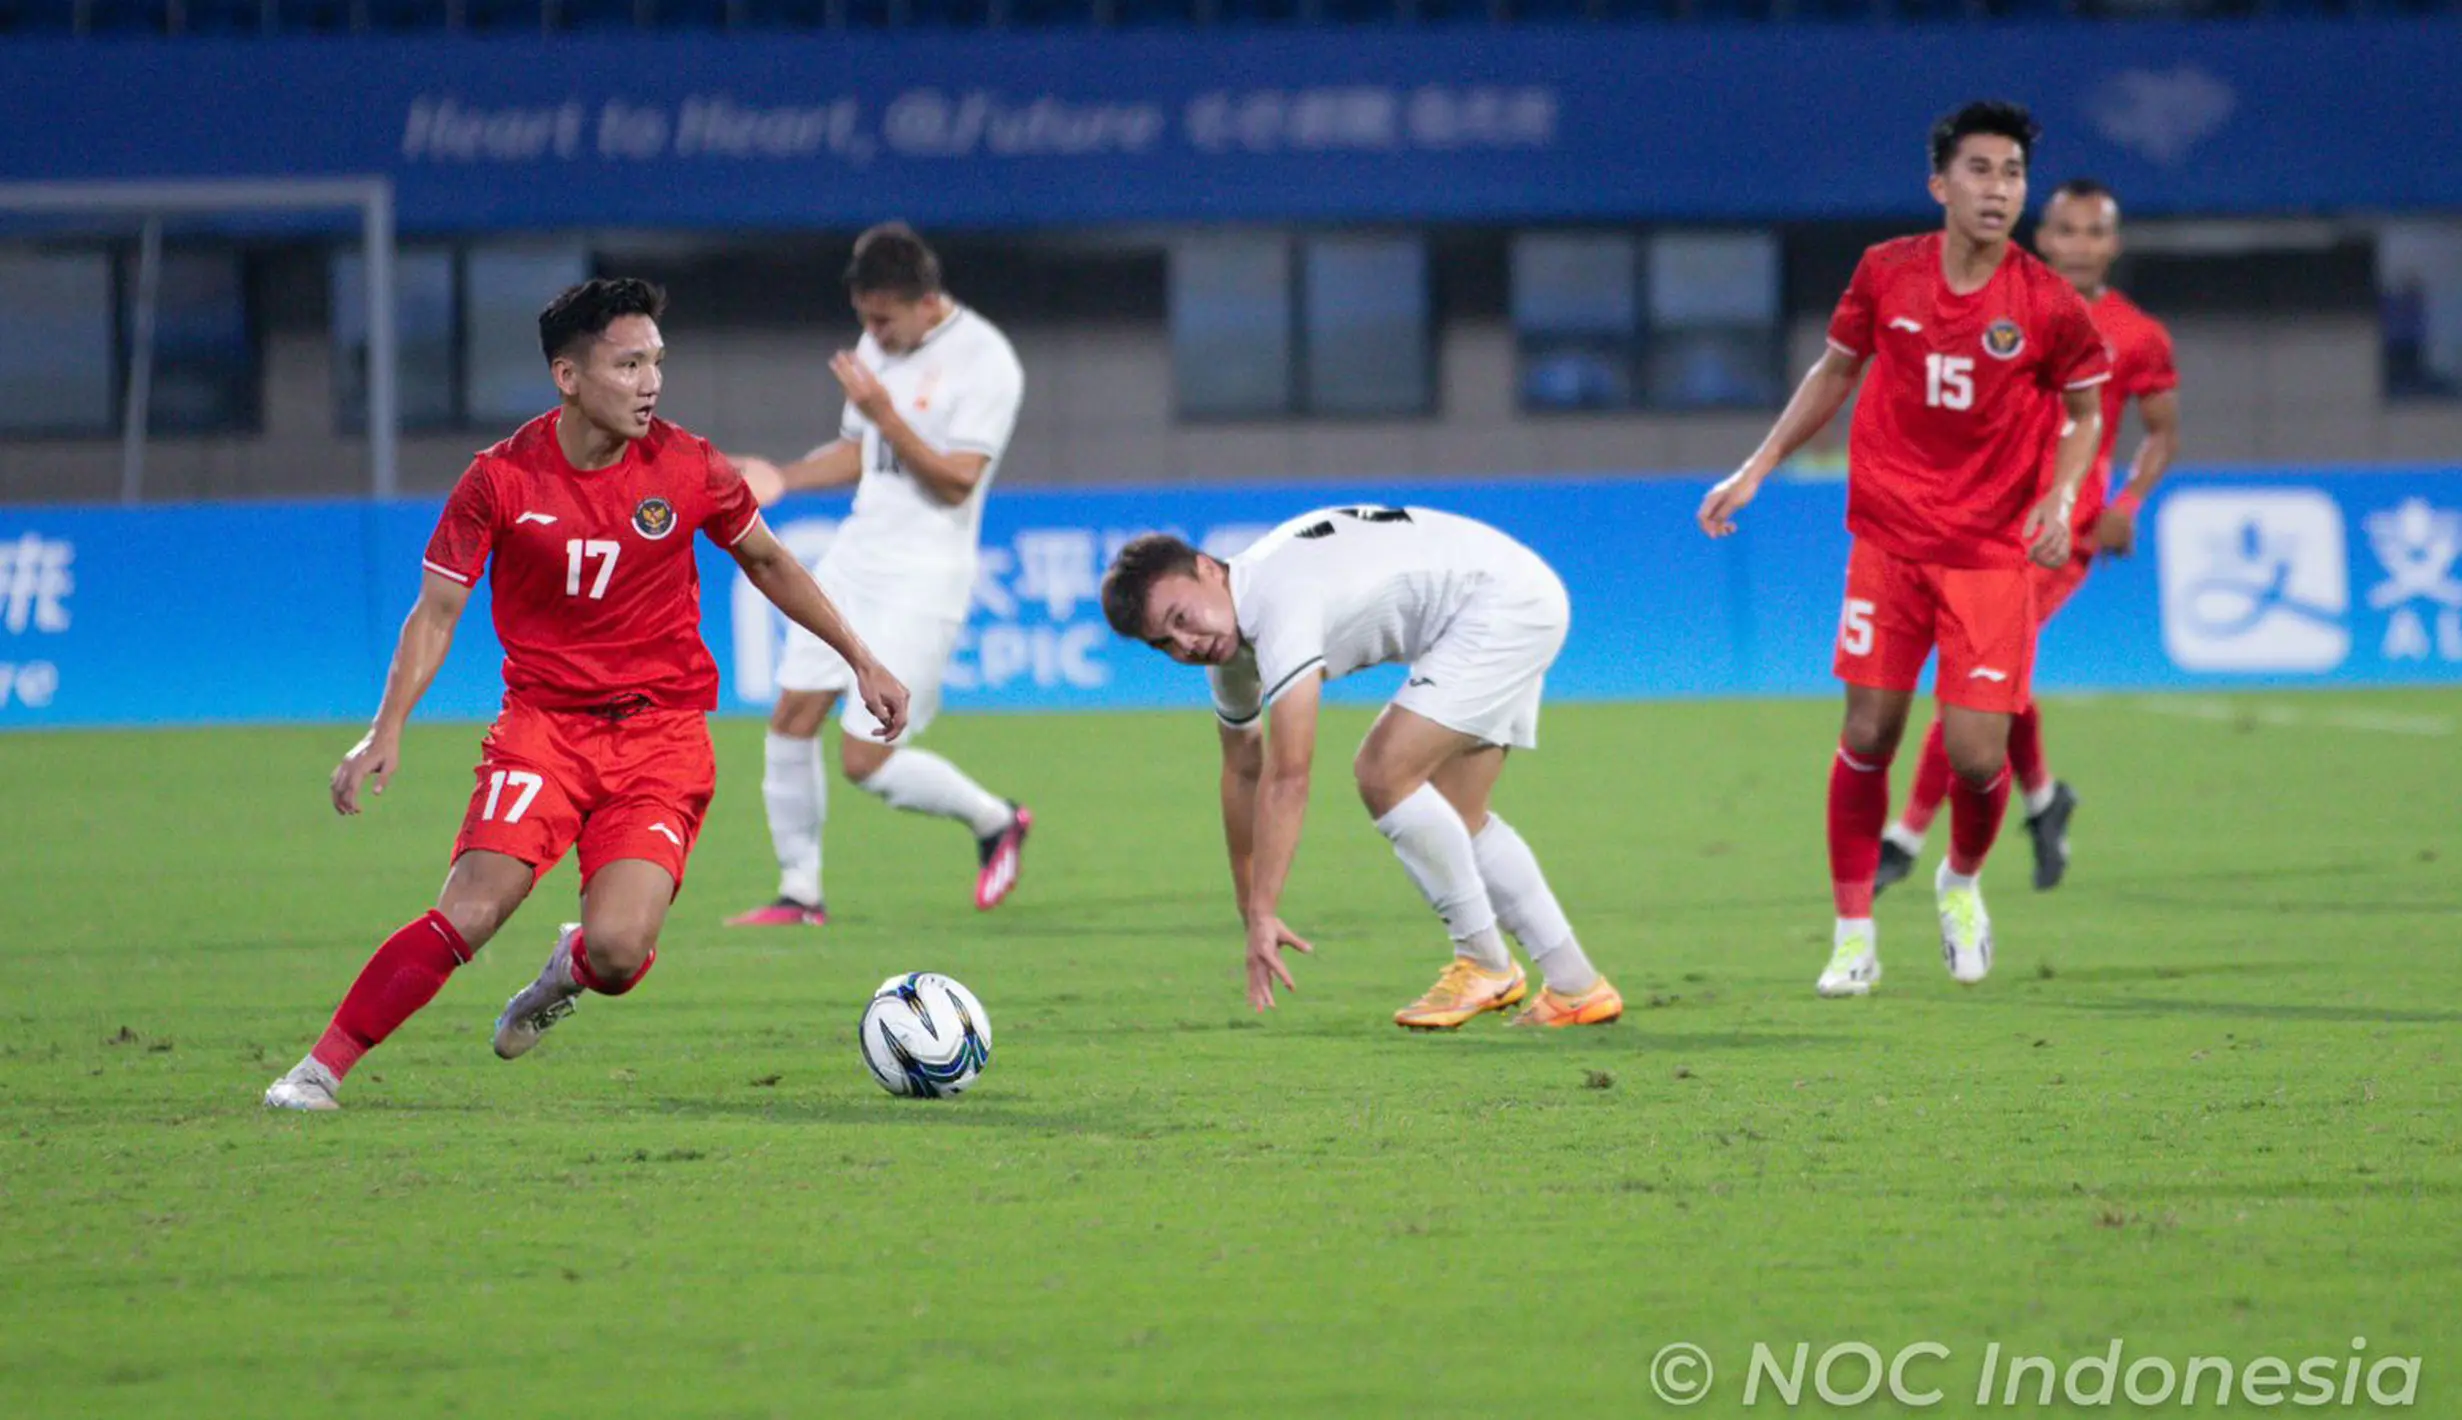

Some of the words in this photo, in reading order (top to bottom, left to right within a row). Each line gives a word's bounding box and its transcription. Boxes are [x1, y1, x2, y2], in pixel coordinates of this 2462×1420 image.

[1925, 353, 1975, 410] 15
[566, 538, 621, 600] 17
[1841, 599, 1876, 657] 5
[482, 770, 543, 824] 17
